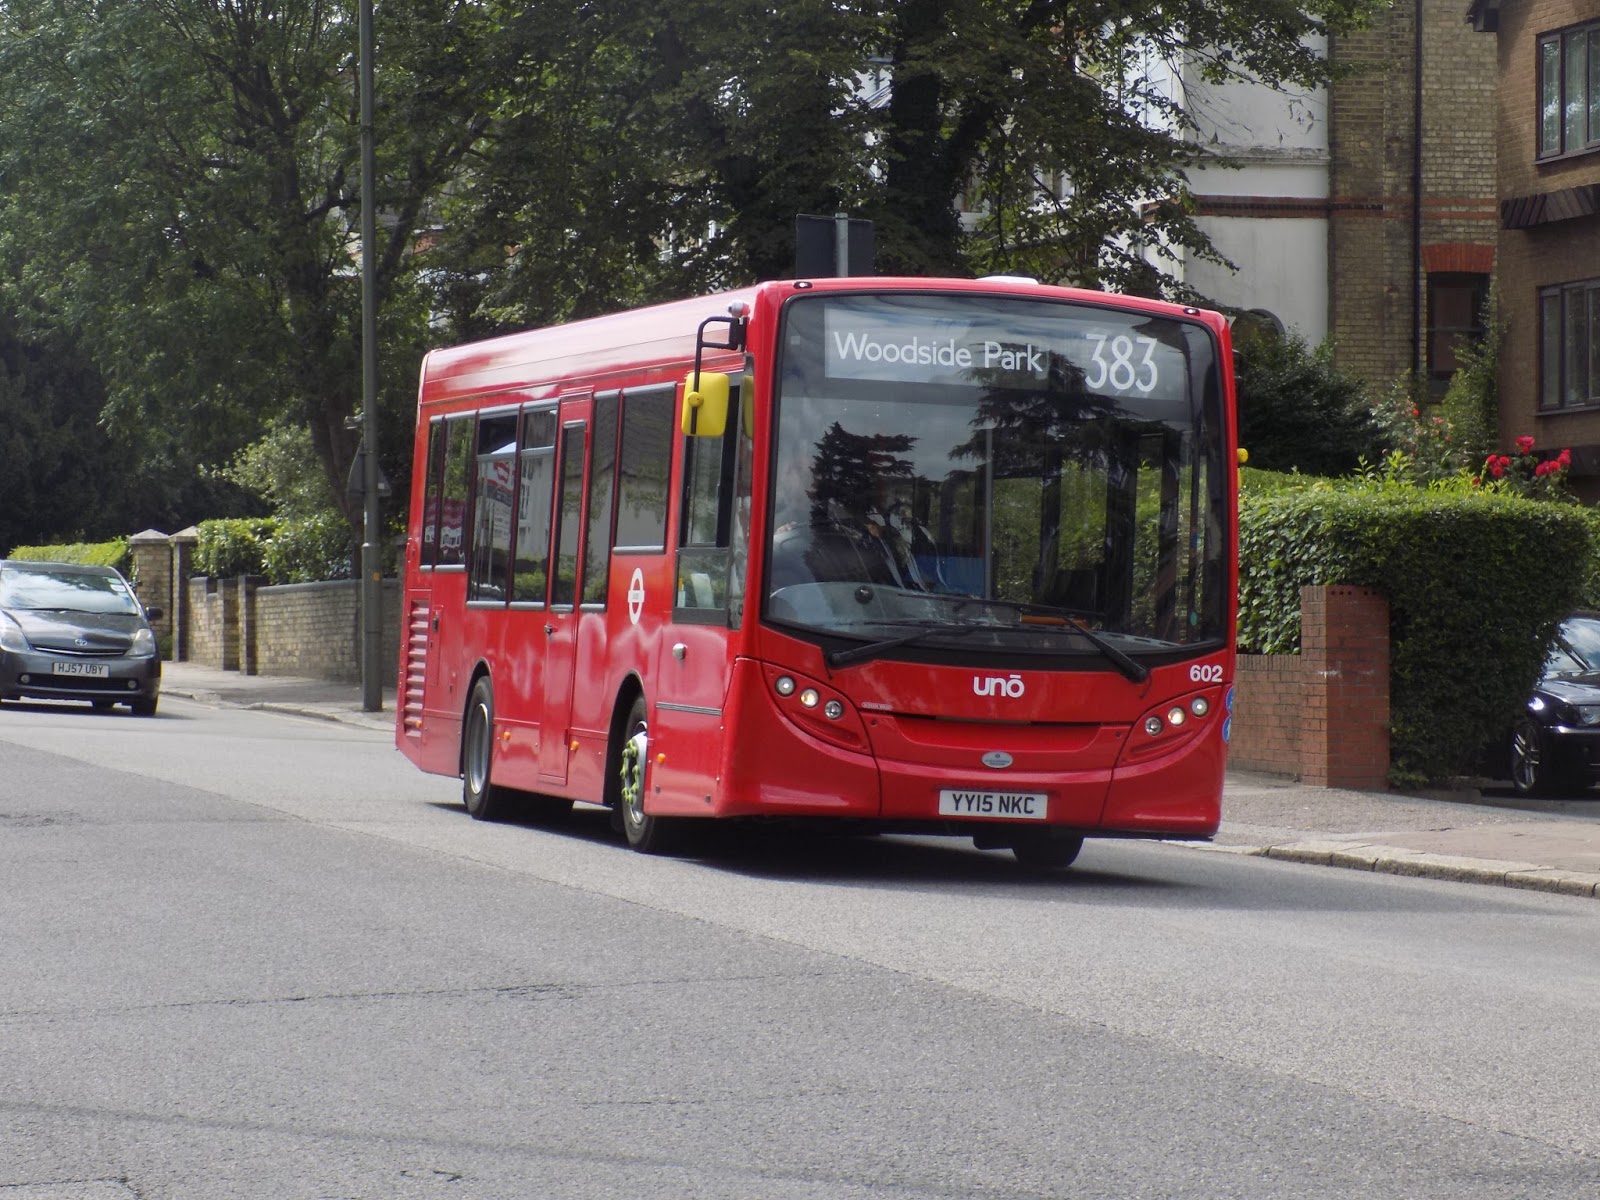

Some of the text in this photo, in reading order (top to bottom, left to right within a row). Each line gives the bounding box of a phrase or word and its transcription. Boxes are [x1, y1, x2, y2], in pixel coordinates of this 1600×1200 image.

[833, 331, 1043, 372] Woodside Park
[1085, 333, 1158, 392] 383
[58, 663, 104, 675] HJ57 UBY
[1189, 664, 1223, 683] 602
[952, 793, 1035, 815] YY15 NKC
